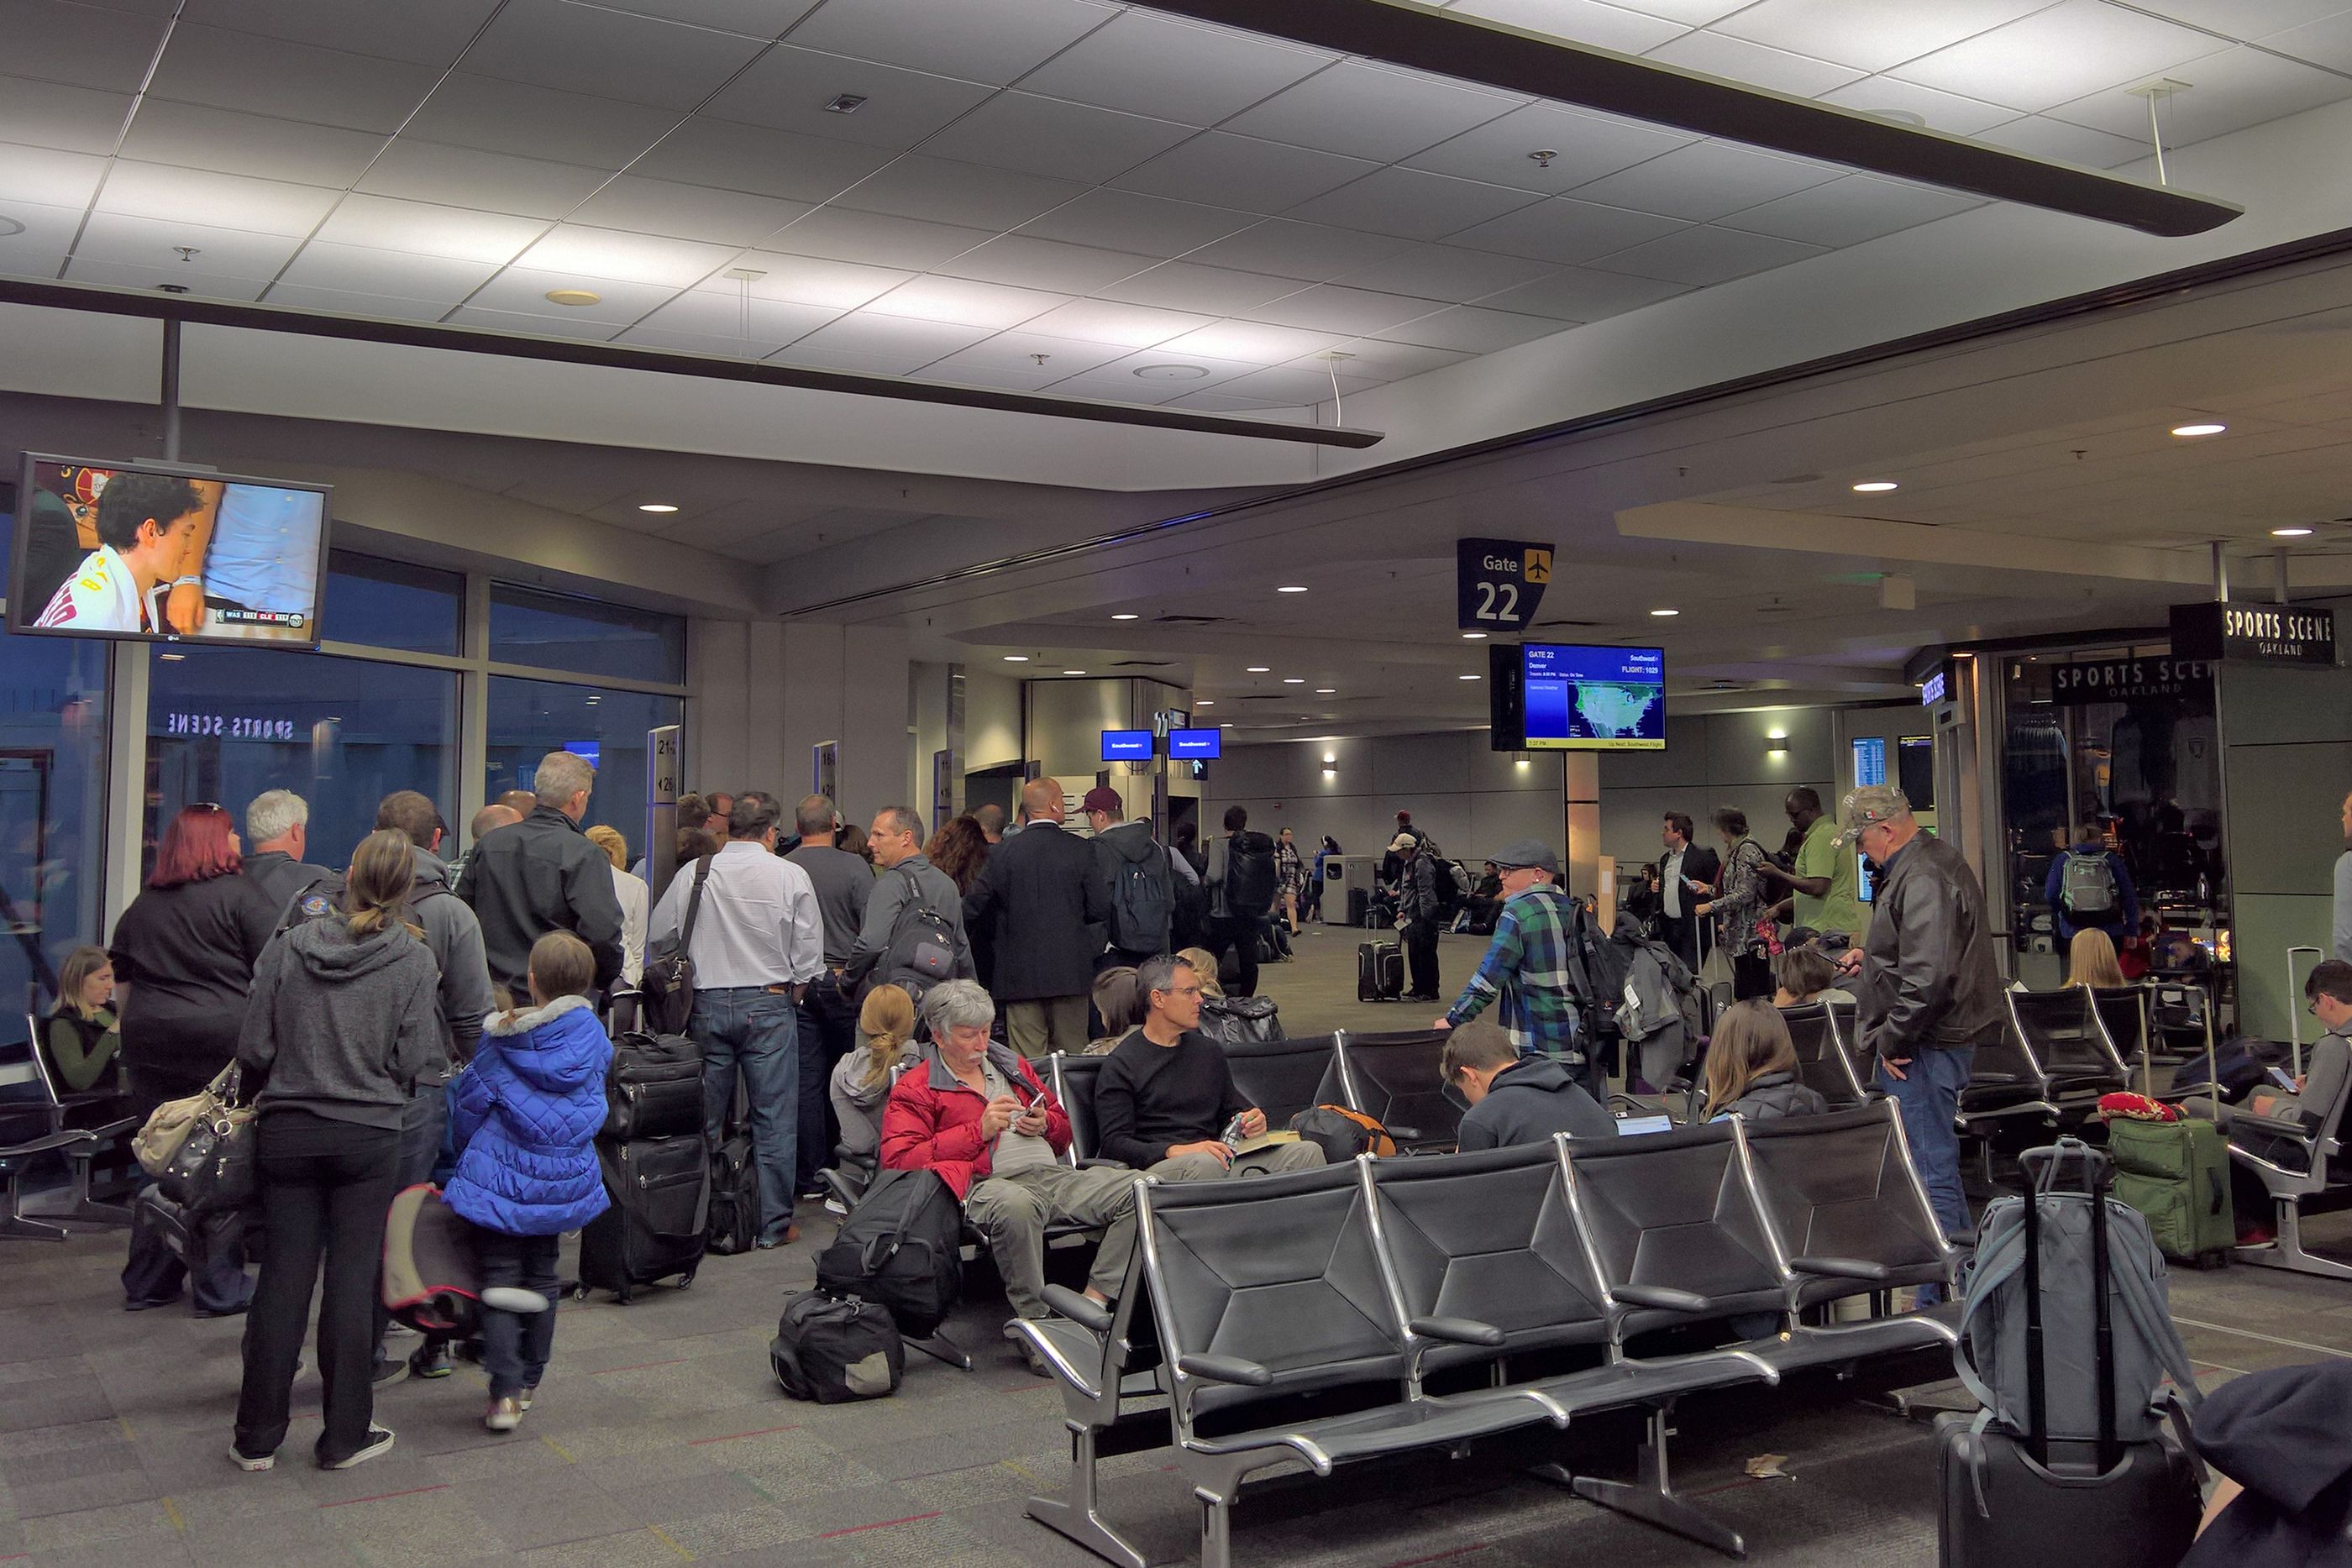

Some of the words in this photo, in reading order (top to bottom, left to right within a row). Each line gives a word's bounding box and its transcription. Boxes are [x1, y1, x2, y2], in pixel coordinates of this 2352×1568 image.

[1483, 554, 1518, 572] Gate
[1477, 581, 1520, 621] 22
[2226, 610, 2281, 639] SPORTS
[2289, 613, 2331, 642] SCENE
[1529, 650, 1546, 658] GATE
[2259, 642, 2302, 656] OAKLAND
[2058, 663, 2143, 689] SPORTS
[2109, 684, 2182, 698] OAKLAND
